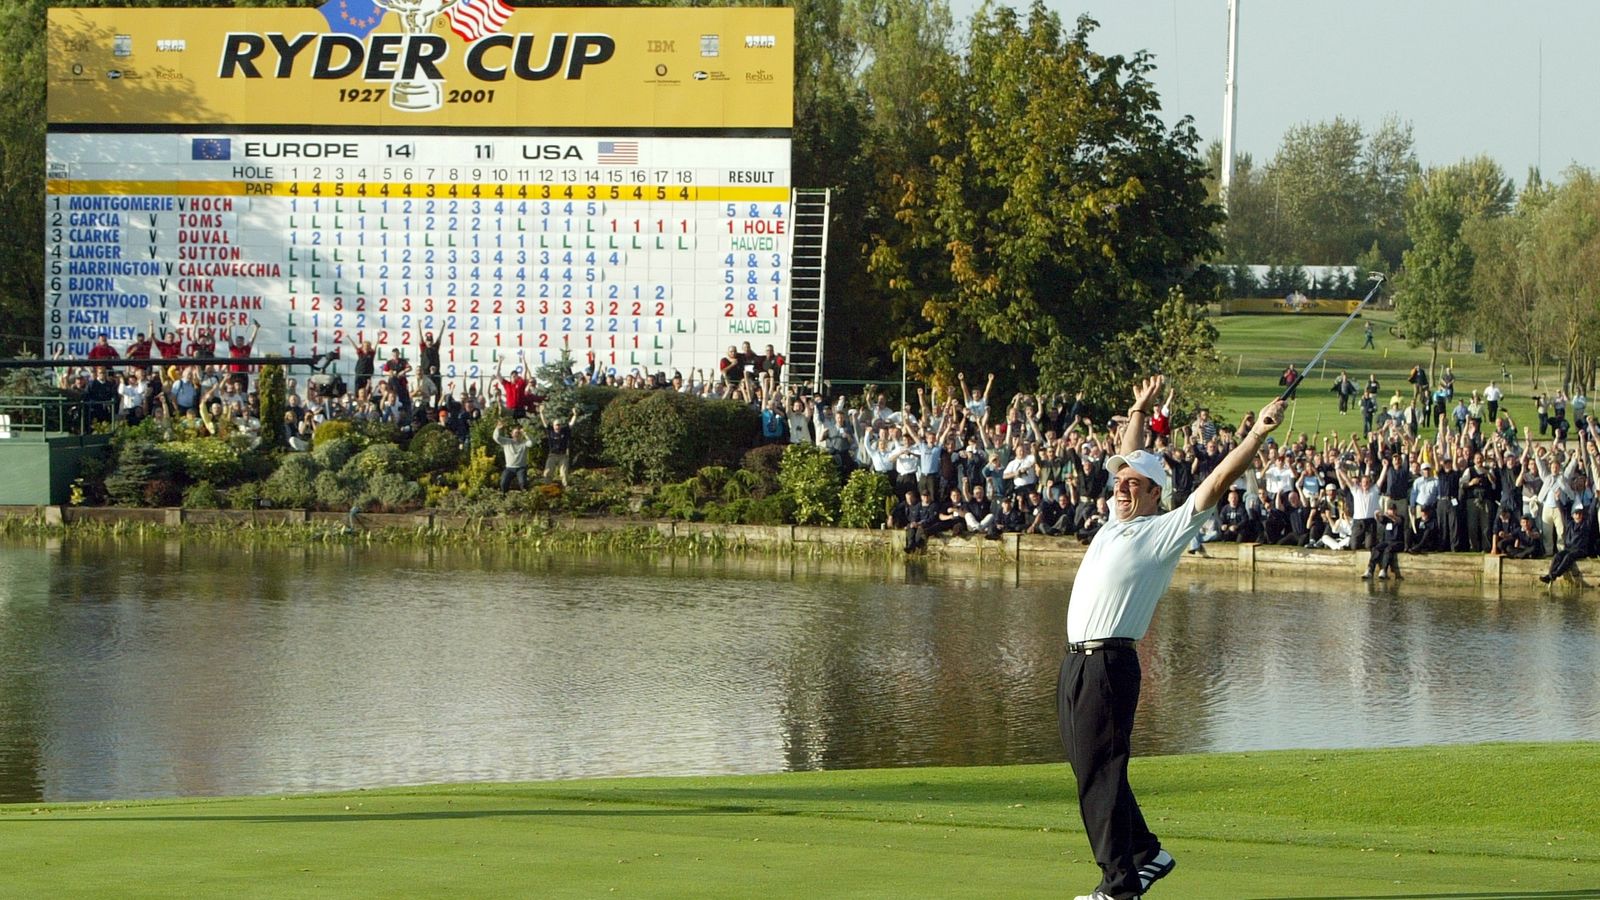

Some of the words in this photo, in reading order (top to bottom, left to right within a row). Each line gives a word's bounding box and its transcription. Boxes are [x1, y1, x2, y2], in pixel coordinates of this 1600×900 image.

[218, 33, 447, 80] RYDER
[466, 34, 615, 81] CUP
[647, 40, 675, 53] IBM
[745, 72, 774, 82] Regus
[338, 88, 387, 103] 1927
[447, 89, 496, 104] 2001
[244, 143, 359, 158] EUROPE
[386, 144, 412, 158] 14
[474, 145, 492, 159] 11
[523, 145, 583, 160] USA
[233, 166, 274, 179] HOLE
[292, 167, 297, 179] 1
[313, 167, 321, 179] 2
[335, 167, 344, 180] 3
[358, 168, 366, 179] 4
[383, 168, 392, 180] 5
[404, 168, 412, 180] 6
[427, 168, 435, 180] 7
[449, 168, 458, 180] 8
[472, 168, 481, 180] 9
[492, 169, 508, 181] 10
[517, 170, 528, 181] 11
[539, 169, 553, 182] 12
[562, 170, 576, 182] 13
[585, 170, 599, 182] 14
[608, 170, 622, 182] 15
[631, 170, 646, 182] 16
[654, 170, 668, 182] 17
[676, 170, 692, 183] 18
[728, 170, 775, 184] RESULT
[245, 182, 274, 195] PAR
[289, 182, 298, 196] 4
[312, 183, 320, 196] 4
[335, 183, 344, 196] 5
[357, 183, 366, 196] 4
[380, 183, 389, 197] 4
[403, 184, 412, 197] 4
[426, 184, 435, 198] 3
[448, 184, 457, 198] 4
[471, 184, 480, 198] 4
[495, 185, 504, 198] 4
[518, 185, 527, 198] 4
[541, 185, 550, 199] 3
[564, 186, 573, 199] 4
[587, 186, 596, 199] 3
[610, 186, 619, 199] 5
[633, 186, 642, 200] 4
[657, 186, 666, 200] 5
[679, 186, 688, 200] 4
[53, 197, 60, 210] 1
[69, 197, 173, 211] MONTGOMERIE
[178, 198, 186, 211] V
[190, 198, 233, 212] HOCH
[291, 199, 296, 212] 1
[313, 199, 318, 212] 1
[335, 200, 343, 212] L
[358, 200, 366, 213] L
[381, 200, 387, 213] 1
[403, 200, 412, 214] 2
[426, 200, 434, 214] 2
[449, 200, 458, 214] 2
[471, 201, 480, 214] 3
[494, 201, 504, 214] 4
[517, 201, 527, 215] 4
[541, 201, 550, 215] 3
[563, 202, 573, 215] 4
[587, 202, 596, 216] 5
[727, 203, 737, 218] 5
[748, 203, 760, 218] &
[772, 204, 783, 218] 4
[52, 213, 62, 227] 2
[70, 213, 120, 227] GARCIA
[149, 213, 157, 227] V
[179, 214, 223, 228] TOMS
[726, 220, 734, 234] 1
[744, 220, 785, 235] HOLE
[52, 229, 62, 243] 3
[69, 229, 120, 243] CLARKE
[149, 229, 157, 243] V
[178, 230, 230, 244] DUVAL
[731, 236, 774, 251] HALVED
[51, 245, 62, 258] 4
[69, 245, 121, 259] LANGER
[149, 246, 157, 259] V
[178, 246, 241, 260] SUTTON
[288, 247, 298, 261] L
[311, 249, 320, 262] L
[333, 248, 343, 262] L
[357, 249, 365, 262] L
[381, 249, 387, 262] 1
[402, 249, 411, 263] 2
[425, 249, 434, 263] 2
[448, 249, 457, 264] 3
[471, 250, 480, 264] 3
[725, 252, 735, 267] 4
[747, 253, 758, 268] &
[771, 253, 781, 268] 3
[51, 261, 62, 275] 5
[69, 261, 160, 276] HARRINGTON
[166, 262, 174, 276] V
[178, 262, 281, 277] CALCAVECCHIA
[725, 269, 735, 284] 5
[747, 270, 758, 284] &
[770, 270, 781, 284] 4
[51, 277, 62, 291] 6
[69, 277, 114, 292] BJORN
[160, 279, 167, 292] V
[178, 279, 214, 293] CINK
[725, 286, 735, 300] 2
[747, 286, 758, 301] &
[772, 287, 779, 301] 1
[51, 294, 62, 307] 7
[69, 294, 149, 308] WESTWOOD
[160, 295, 167, 308] V
[178, 295, 262, 310] VERPLANK
[289, 297, 295, 310] 1
[311, 297, 320, 310] 2
[334, 297, 342, 311] 3
[356, 297, 365, 311] 2
[379, 298, 388, 312] 2
[401, 298, 410, 312] 3
[424, 298, 433, 312] 3
[447, 299, 456, 312] 2
[470, 299, 479, 313] 2
[493, 300, 502, 314] 2
[516, 300, 525, 314] 3
[539, 300, 548, 314] 3
[562, 300, 571, 314] 3
[585, 301, 594, 315] 3
[609, 301, 618, 315] 2
[632, 302, 640, 316] 2
[655, 302, 664, 316] 2
[724, 303, 734, 317] 2
[747, 303, 758, 318] &
[772, 303, 779, 318] 1
[51, 309, 62, 324] 8
[68, 310, 109, 324] FASTH
[160, 311, 167, 325] V
[178, 311, 248, 325] AZINGER
[729, 320, 771, 334] HALVED
[51, 325, 62, 340] 9
[159, 327, 167, 340] V
